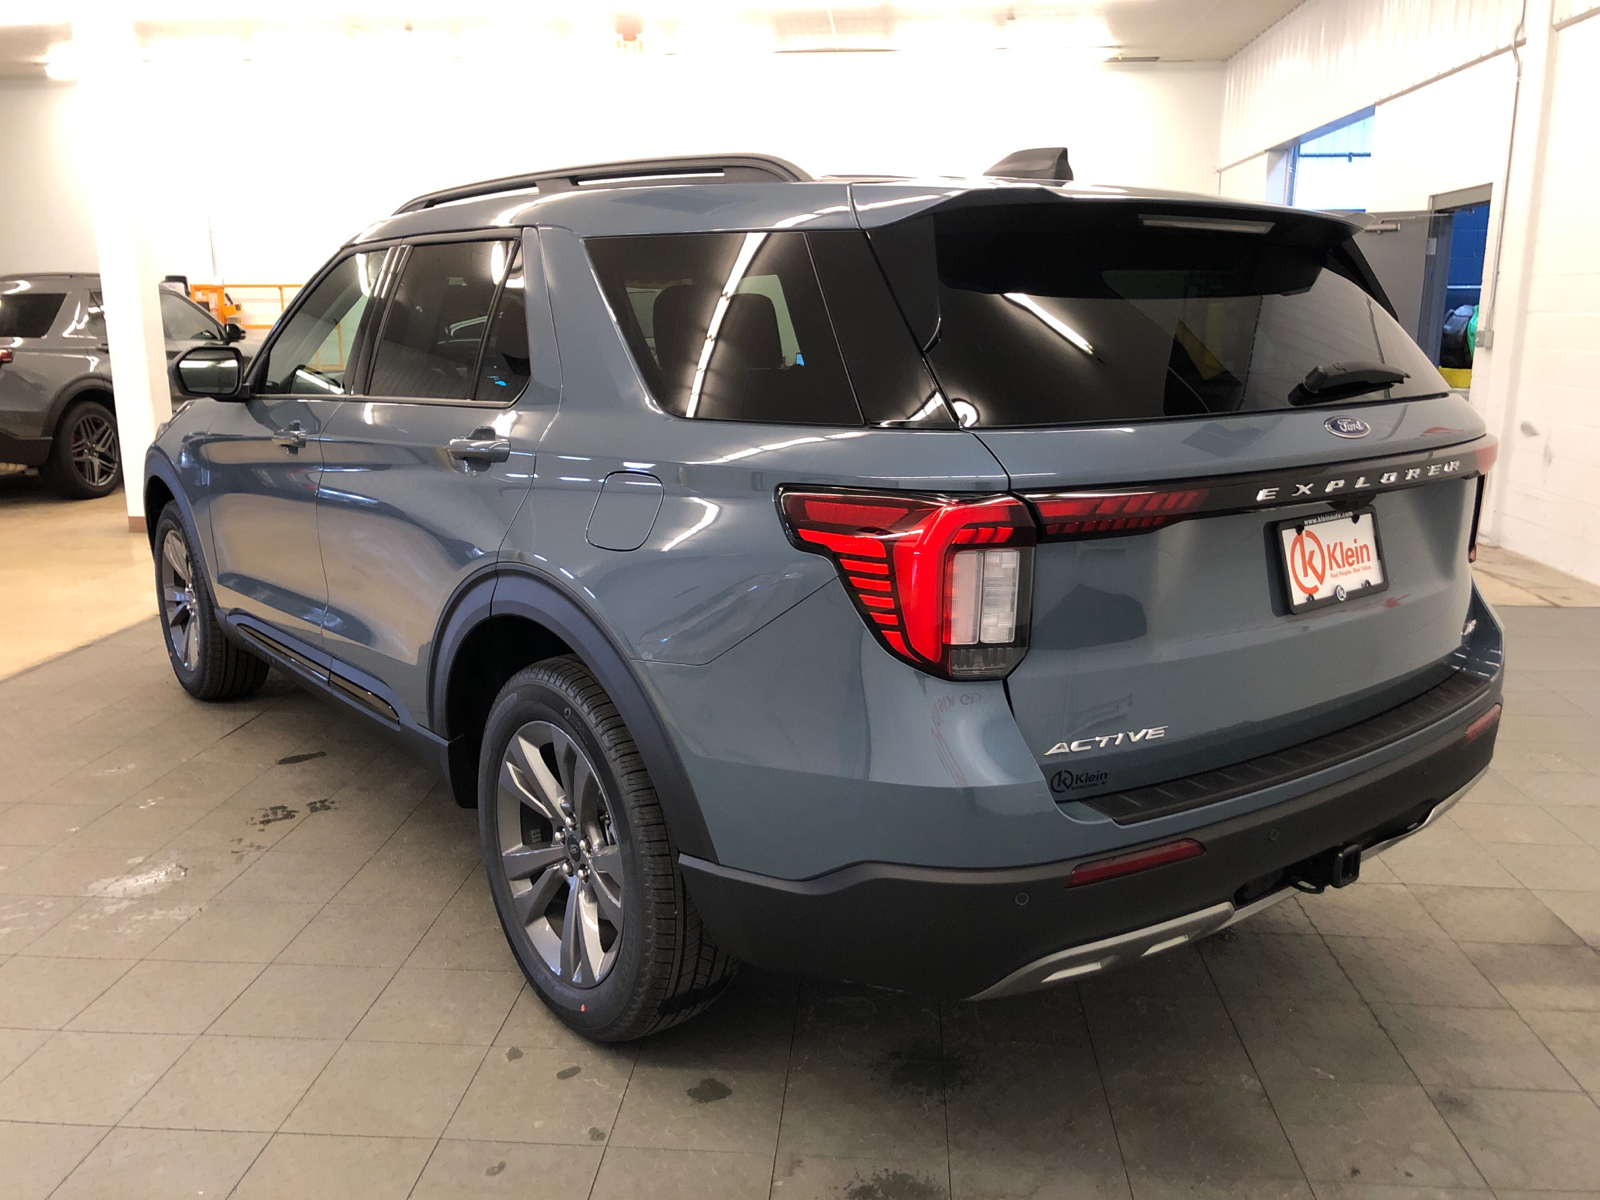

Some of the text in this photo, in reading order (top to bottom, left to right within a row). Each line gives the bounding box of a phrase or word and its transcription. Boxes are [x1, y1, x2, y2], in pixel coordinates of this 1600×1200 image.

[1336, 418, 1364, 433] Ford
[1255, 460, 1462, 502] EXPLORER
[1303, 511, 1354, 526] www.kleinauto.com
[1326, 538, 1371, 571] Klein
[1043, 725, 1169, 756] ACTIVE
[1075, 770, 1108, 785] Klein
